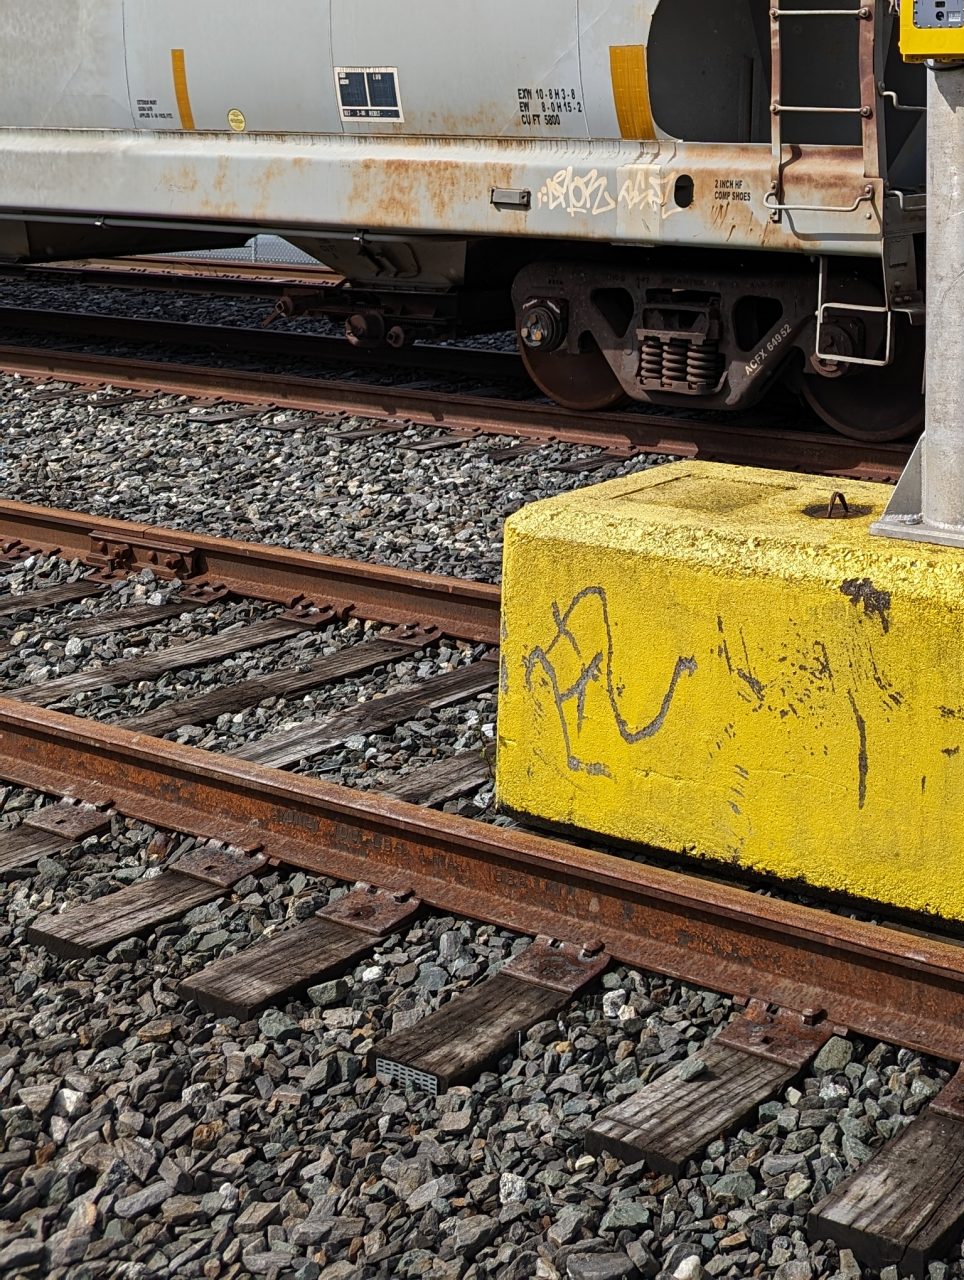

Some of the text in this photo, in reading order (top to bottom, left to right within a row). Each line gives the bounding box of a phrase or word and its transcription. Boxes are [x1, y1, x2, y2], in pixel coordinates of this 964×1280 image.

[518, 88, 532, 100] EXW
[519, 101, 530, 113] EW
[720, 179, 733, 190] INCH
[714, 191, 751, 201] COMP SHOES
[745, 323, 792, 376] ACFX 64952
